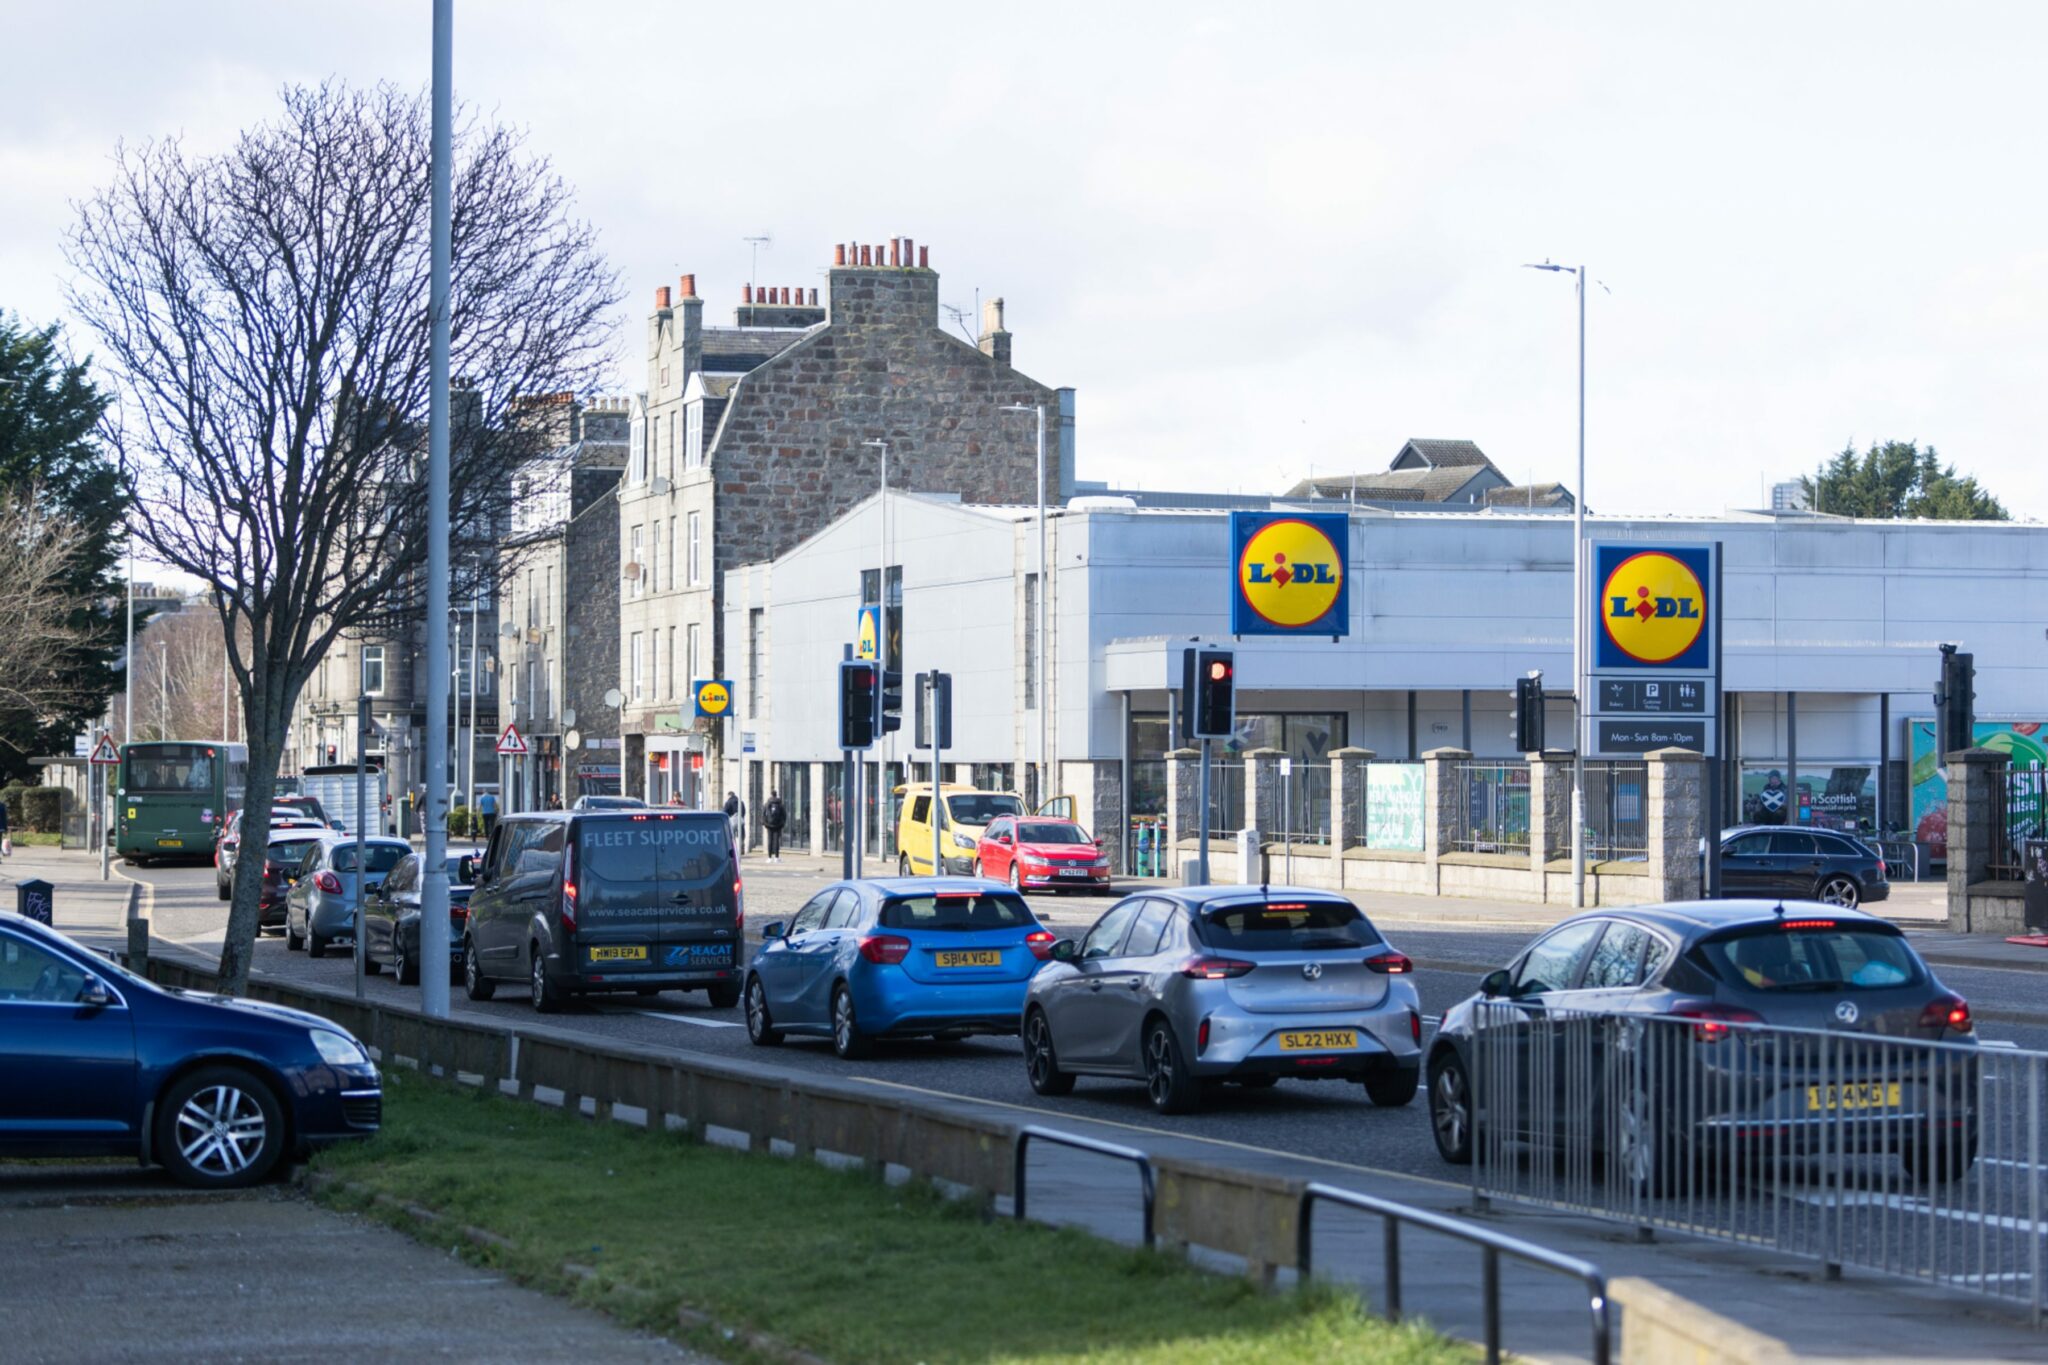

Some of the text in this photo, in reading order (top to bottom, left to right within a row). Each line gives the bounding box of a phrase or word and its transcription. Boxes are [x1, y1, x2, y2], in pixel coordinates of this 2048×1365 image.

[1611, 733, 1629, 742] Mon
[1634, 733, 1648, 742] Sun
[1651, 733, 1667, 742] 8am
[1673, 733, 1693, 743] 10pm
[1818, 792, 1857, 804] Scottish
[584, 830, 720, 847] FLEET SUPPORT
[621, 947, 640, 957] EPA
[691, 945, 732, 956] SEACAT
[691, 956, 732, 966] SERVICES
[943, 951, 994, 964] SB14 VGJ
[1285, 1031, 1353, 1048] SL22 HXX
